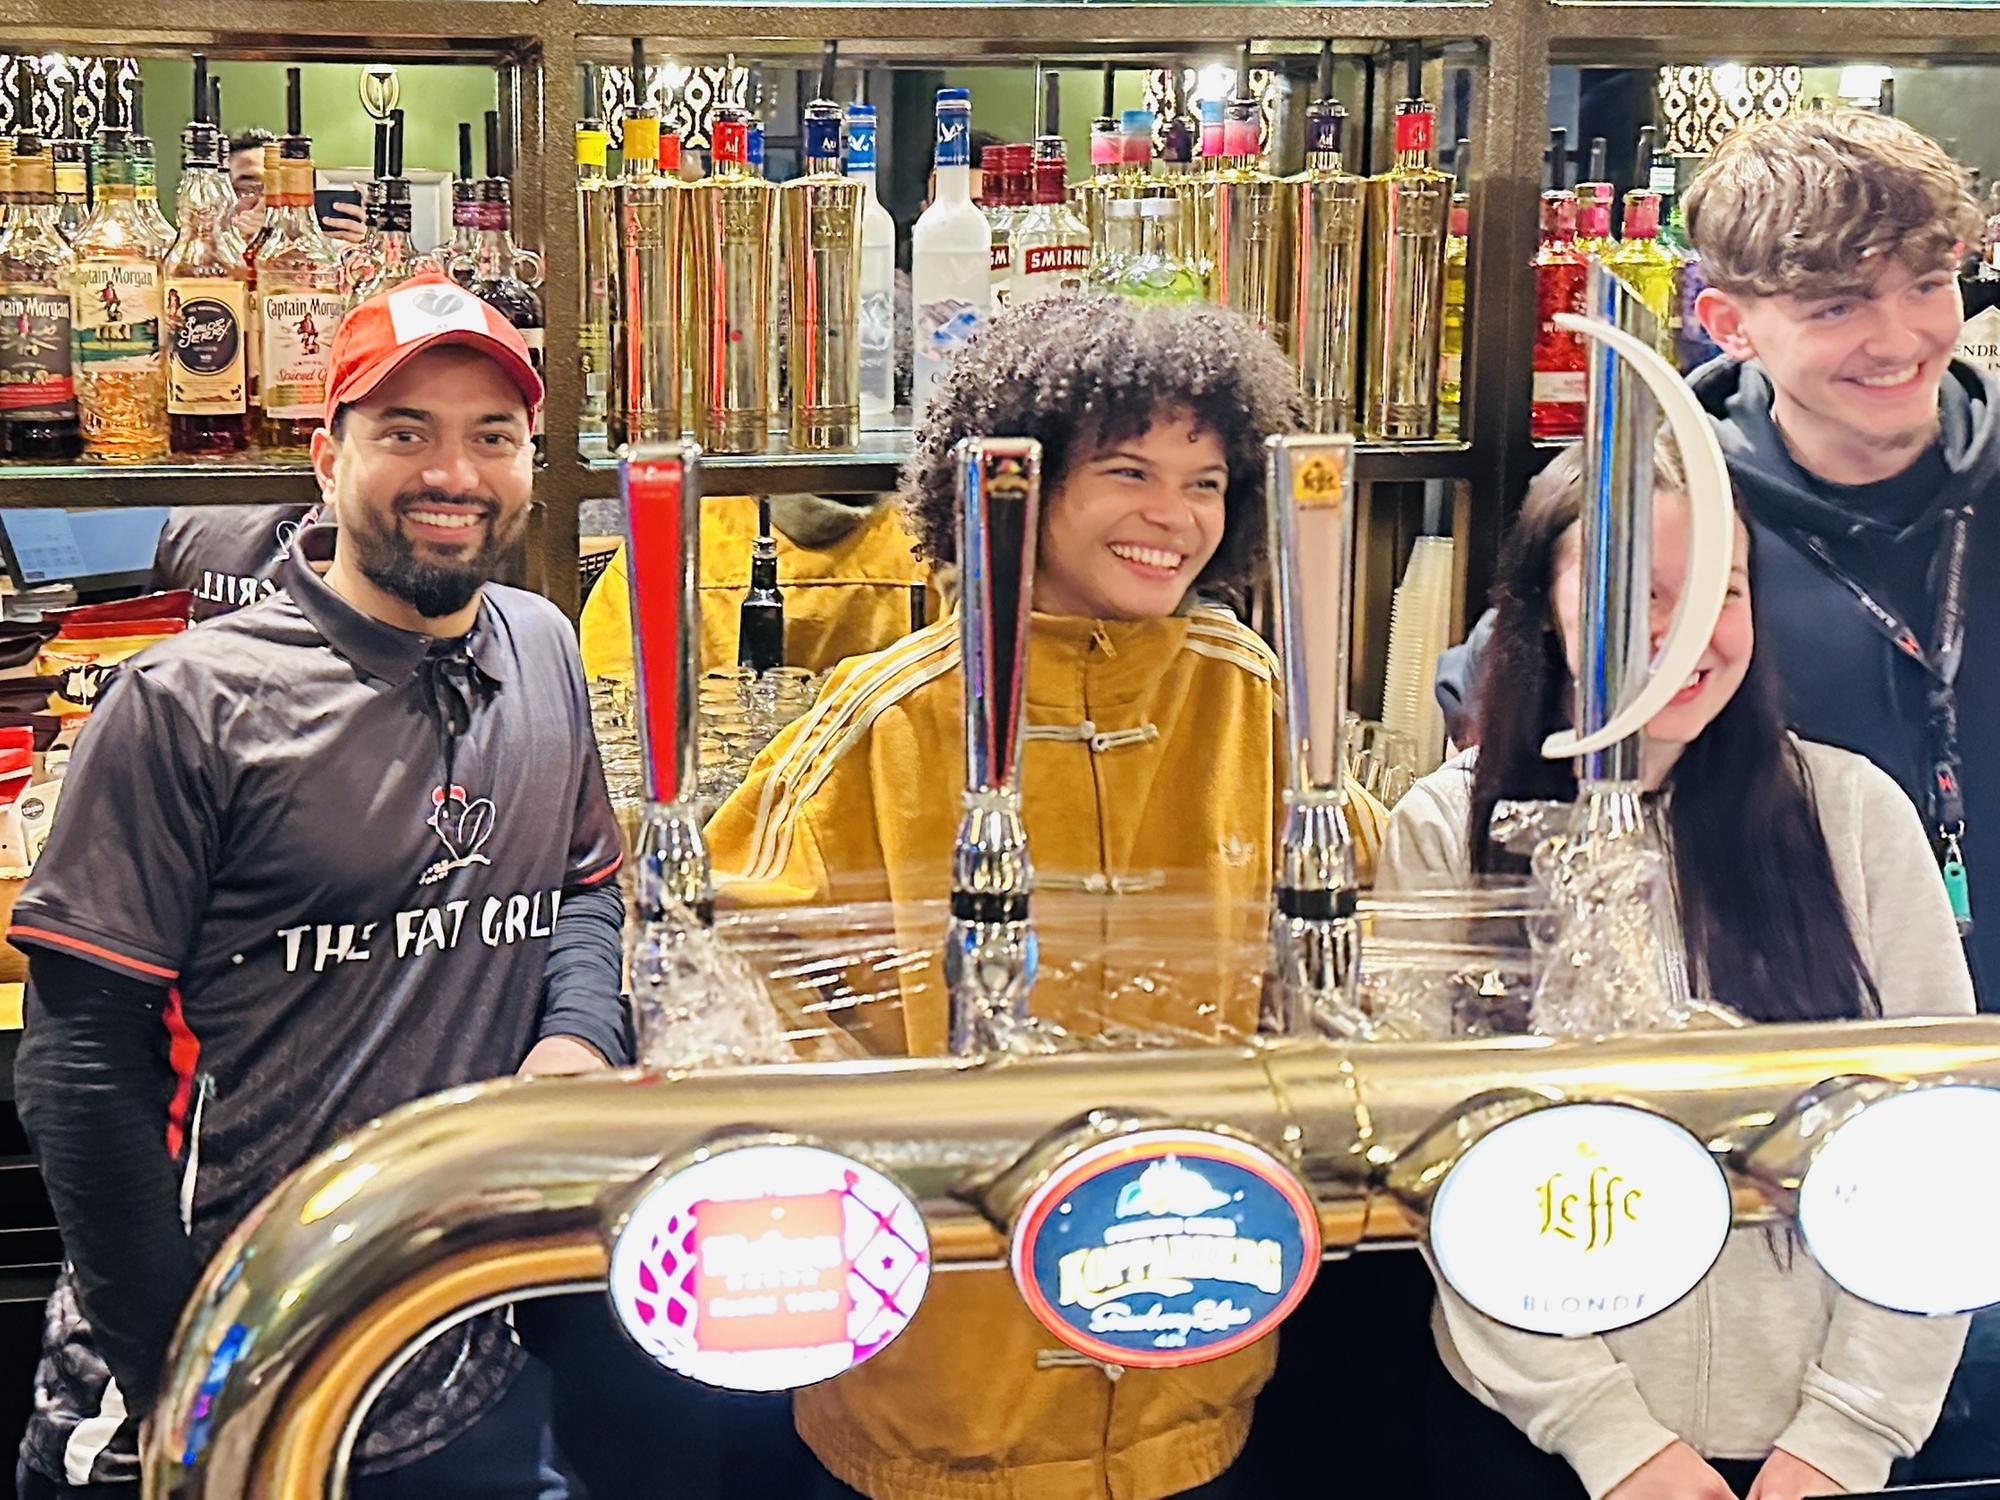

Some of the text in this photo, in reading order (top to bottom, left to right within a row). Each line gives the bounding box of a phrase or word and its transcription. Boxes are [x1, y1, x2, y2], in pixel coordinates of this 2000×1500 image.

[111, 266, 153, 288] Morgan
[26, 297, 69, 320] Morgan
[266, 298, 308, 320] Captain
[395, 899, 470, 959] FAT
[1535, 1165, 1642, 1251] Leffe
